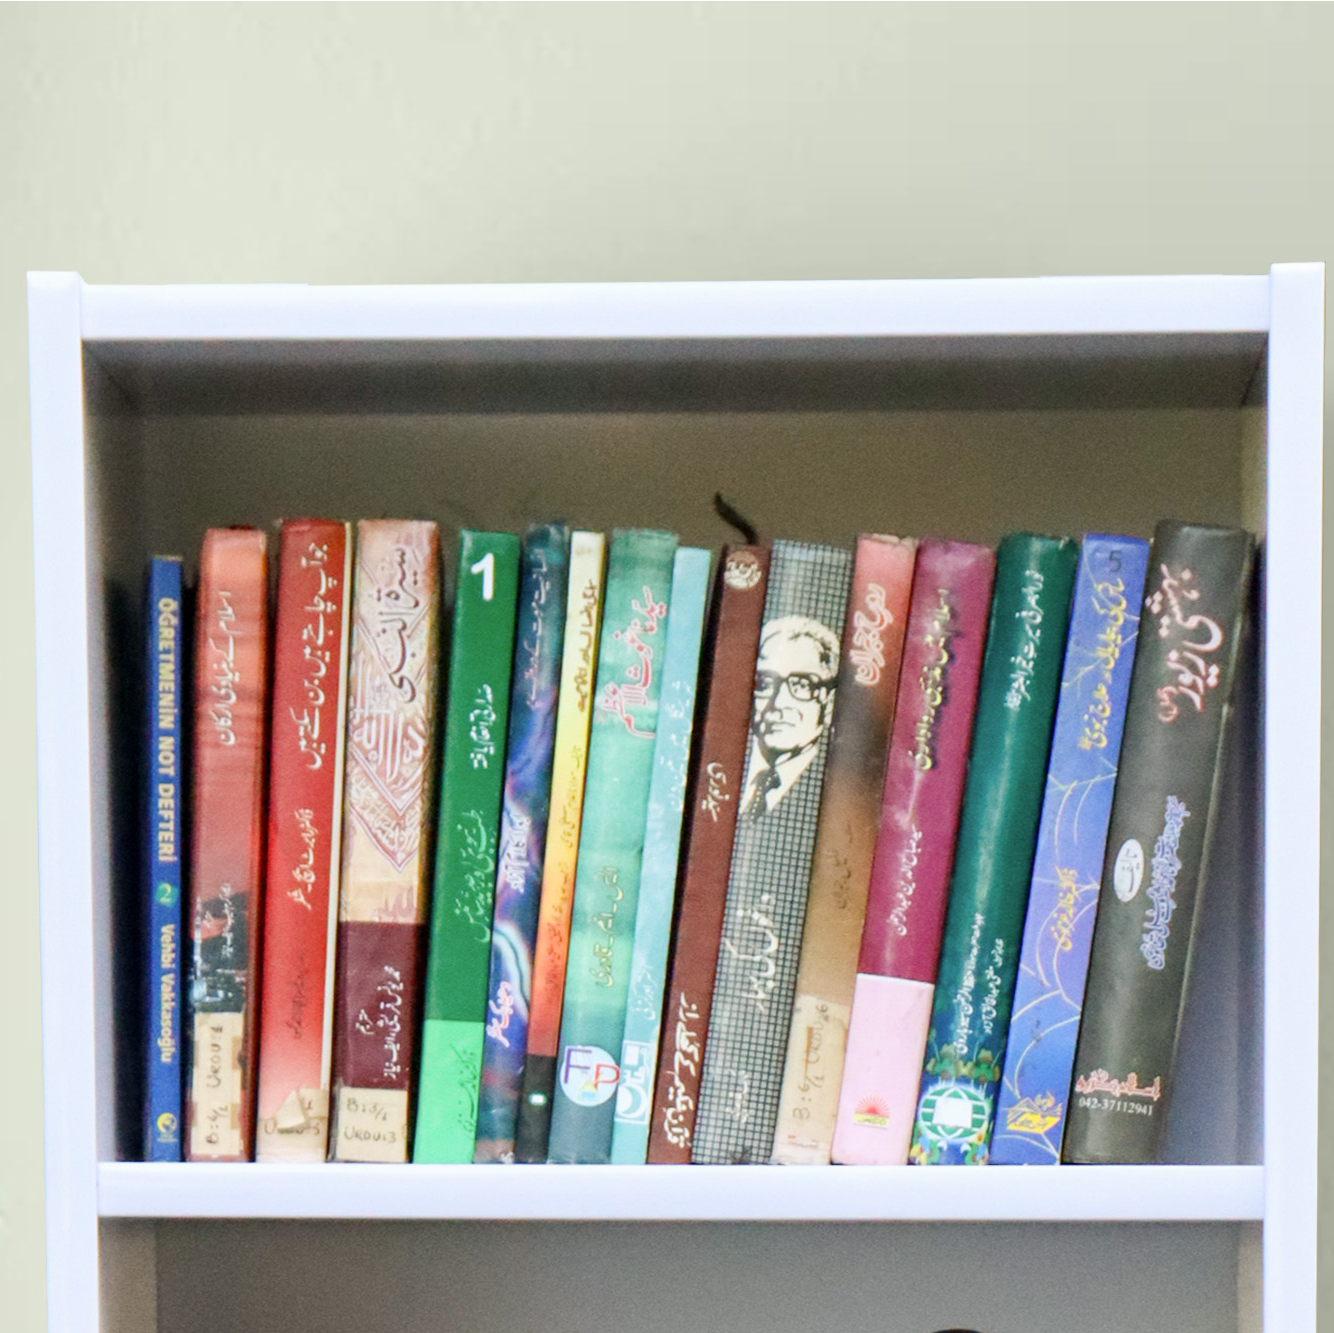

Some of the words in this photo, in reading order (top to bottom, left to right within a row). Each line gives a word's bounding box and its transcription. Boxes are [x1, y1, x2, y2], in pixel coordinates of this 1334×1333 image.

[307, 544, 328, 563] جو
[1108, 550, 1124, 574] 5
[299, 561, 338, 598] آپ
[466, 550, 496, 601] 1
[216, 589, 243, 634] اسلام
[301, 596, 336, 649] چاہتے
[157, 598, 179, 728] ÖĞRETMENİN
[301, 648, 329, 682] ہیں
[213, 663, 239, 702] بنیادی
[302, 681, 324, 710] بن
[214, 703, 236, 745] ارکان
[288, 709, 319, 743] سکتے
[157, 736, 175, 776] NOT
[297, 741, 324, 774] ہیں
[156, 782, 177, 862] DEFTERİ
[293, 810, 319, 835] ڈاکٹر
[160, 922, 176, 969] Vehbi
[376, 979, 403, 1000] یونس
[675, 990, 702, 1022] راز
[157, 973, 176, 1063] Vakkasoğlu
[354, 1007, 375, 1036] مترجم
[383, 1036, 401, 1062] ایف
[381, 1060, 402, 1079] نیاز
[1078, 1096, 1154, 1117] 042-37112941
[656, 1106, 696, 1150] قرآن
